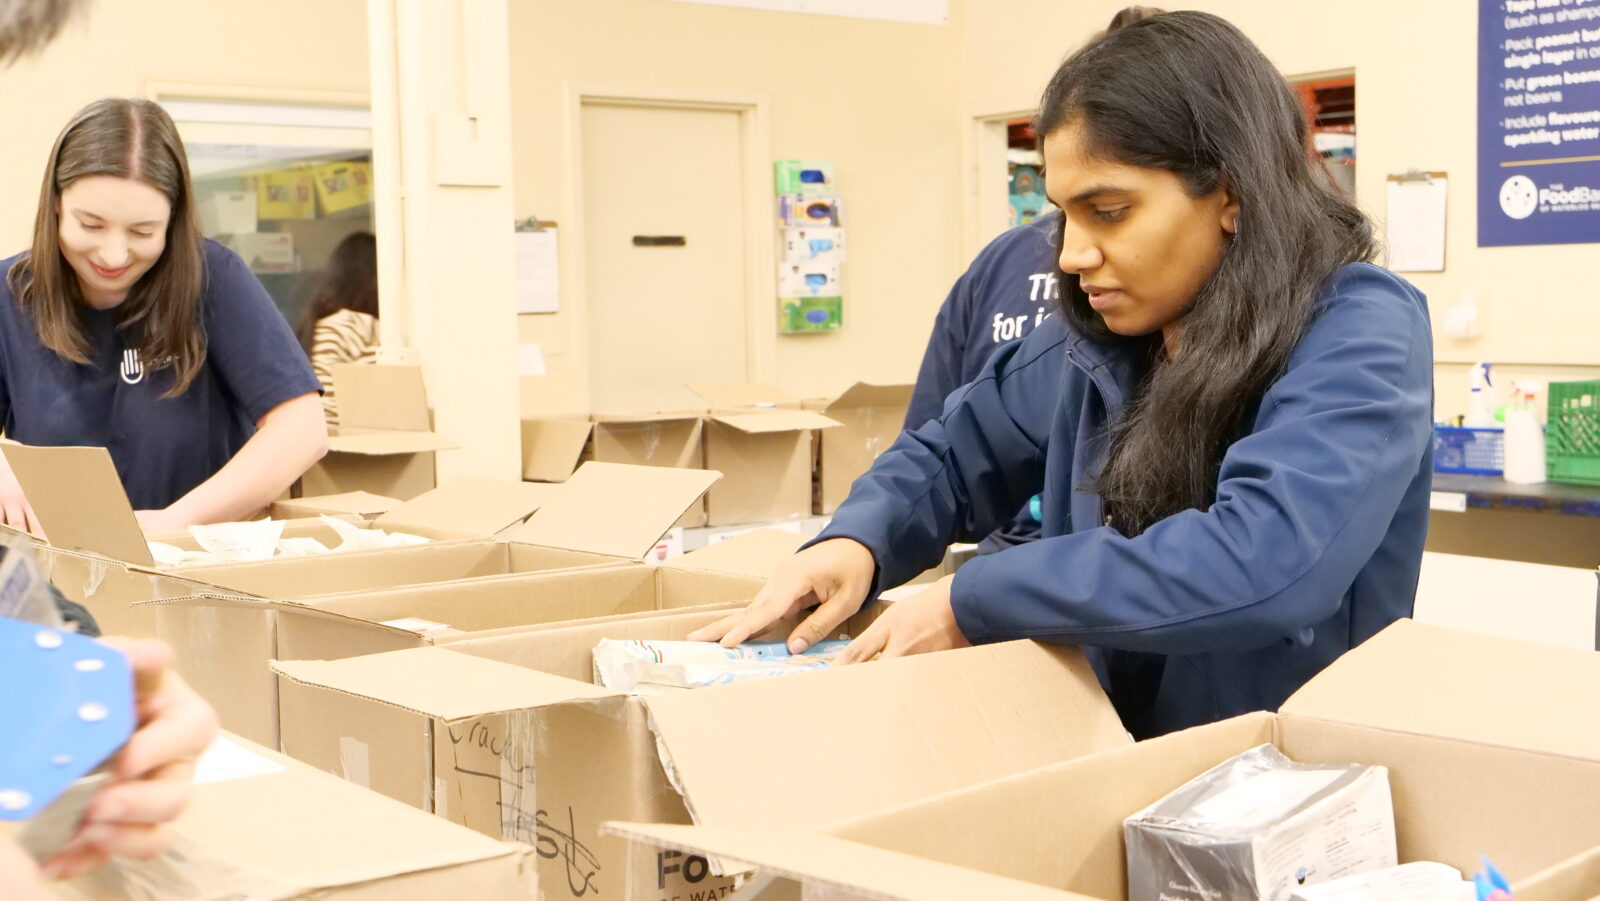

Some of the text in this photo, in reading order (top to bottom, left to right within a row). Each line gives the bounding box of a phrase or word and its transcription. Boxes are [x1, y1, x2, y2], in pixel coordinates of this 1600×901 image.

[1505, 38, 1534, 51] Pack
[1536, 31, 1579, 51] peanut
[1504, 53, 1540, 68] single
[1542, 50, 1573, 65] layer
[1576, 48, 1588, 59] in
[1505, 78, 1524, 90] Put
[1527, 75, 1562, 91] green
[1504, 92, 1562, 107] not beans
[1505, 115, 1546, 129] Include
[1504, 127, 1599, 147] sparkling water
[993, 307, 1052, 343] for i
